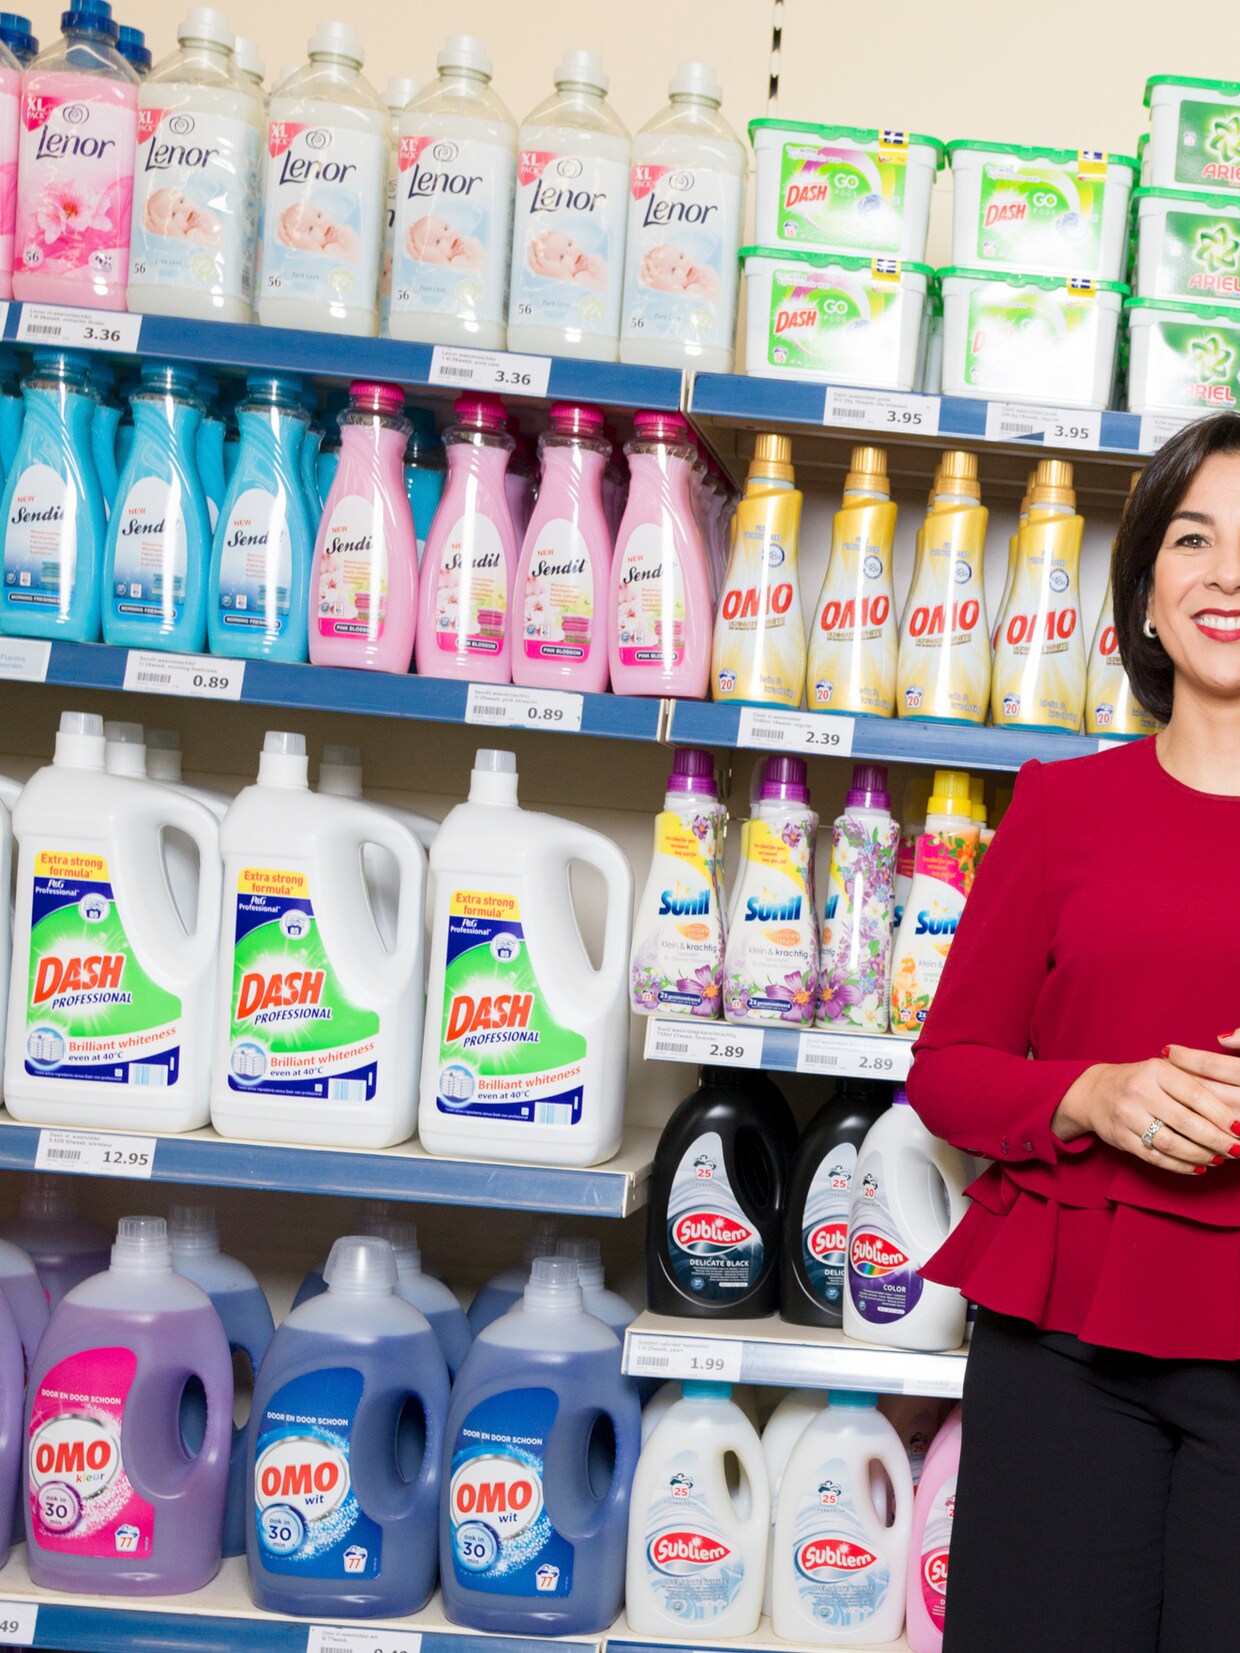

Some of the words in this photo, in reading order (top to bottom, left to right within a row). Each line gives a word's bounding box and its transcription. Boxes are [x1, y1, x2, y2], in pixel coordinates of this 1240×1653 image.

[27, 97, 47, 111] XL
[36, 125, 116, 160] Lenor
[145, 137, 219, 172] Lenor
[279, 150, 357, 186] Lenor
[408, 165, 482, 199] Lenor
[834, 173, 859, 191] GO
[530, 180, 606, 214] Lenor
[786, 184, 828, 208] DASH
[1032, 192, 1058, 208] GO
[643, 193, 717, 228] Lenor
[984, 203, 1026, 228] DASH
[26, 252, 39, 262] 56
[268, 276, 281, 287] 56
[824, 300, 848, 315] GO
[630, 318, 644, 329] 56
[775, 310, 817, 334] DASH
[83, 327, 121, 342] 3.36
[495, 370, 531, 386] 3.36
[886, 411, 922, 425] 3.95
[1054, 425, 1089, 440] 3.95
[17, 495, 34, 503] NEW
[532, 560, 586, 577] Sendil
[722, 584, 793, 620] OMO
[820, 595, 890, 631] OMO
[909, 599, 980, 637] OMO
[1006, 608, 1076, 645] OMO
[542, 648, 554, 656] PINK
[556, 649, 582, 658] BLOSSOM
[192, 674, 229, 689] 0.89
[720, 679, 732, 690] 20
[527, 707, 563, 721] 0.89
[1005, 703, 1017, 714] 20
[805, 732, 840, 746] 2.39
[40, 853, 68, 865] Extra
[70, 857, 103, 870] strong
[244, 870, 269, 882] Extra
[271, 874, 303, 887] strong
[659, 889, 711, 915] Sunil
[744, 895, 802, 921] Sunil
[686, 942, 717, 953] krachtig
[33, 955, 124, 1004] DASH
[52, 992, 132, 1009] PROFESSIONAL
[236, 971, 324, 1020] DASH
[254, 1007, 332, 1025] PROFESSIONAL
[446, 994, 533, 1042] DASH
[69, 1041, 115, 1053] Brilliant
[118, 1027, 176, 1049] whiteness
[462, 1031, 539, 1048] PROFESSIONAL
[68, 1054, 90, 1062] even
[91, 1053, 100, 1062] at
[102, 1051, 124, 1060] 40°C
[709, 1044, 744, 1058] 2.89
[858, 1057, 893, 1070] 2.89
[102, 1150, 148, 1166] 12.95
[698, 1168, 711, 1178] 25
[681, 1222, 747, 1243] Subliem
[853, 1242, 903, 1266] Subliem
[690, 1259, 724, 1267] DELICATE
[726, 1259, 749, 1268] BLACK
[883, 1284, 906, 1293] COLOR
[691, 1358, 724, 1371] 1.99
[41, 1390, 58, 1398] DOOR
[70, 1393, 89, 1401] DOOR
[90, 1395, 121, 1404] SCHOON
[36, 1440, 111, 1473] OMO
[75, 1472, 105, 1483] kleur
[261, 1461, 338, 1497] OMO
[304, 1494, 324, 1506] wit
[456, 1480, 532, 1513] OMO
[674, 1487, 688, 1497] 25
[45, 1503, 67, 1518] 30
[499, 1511, 518, 1523] wit
[268, 1526, 291, 1541] 30
[120, 1537, 132, 1548] 77
[463, 1543, 485, 1558] 30
[658, 1539, 725, 1561] Subliem
[348, 1558, 360, 1569] 77
[805, 1546, 871, 1568] Subliem
